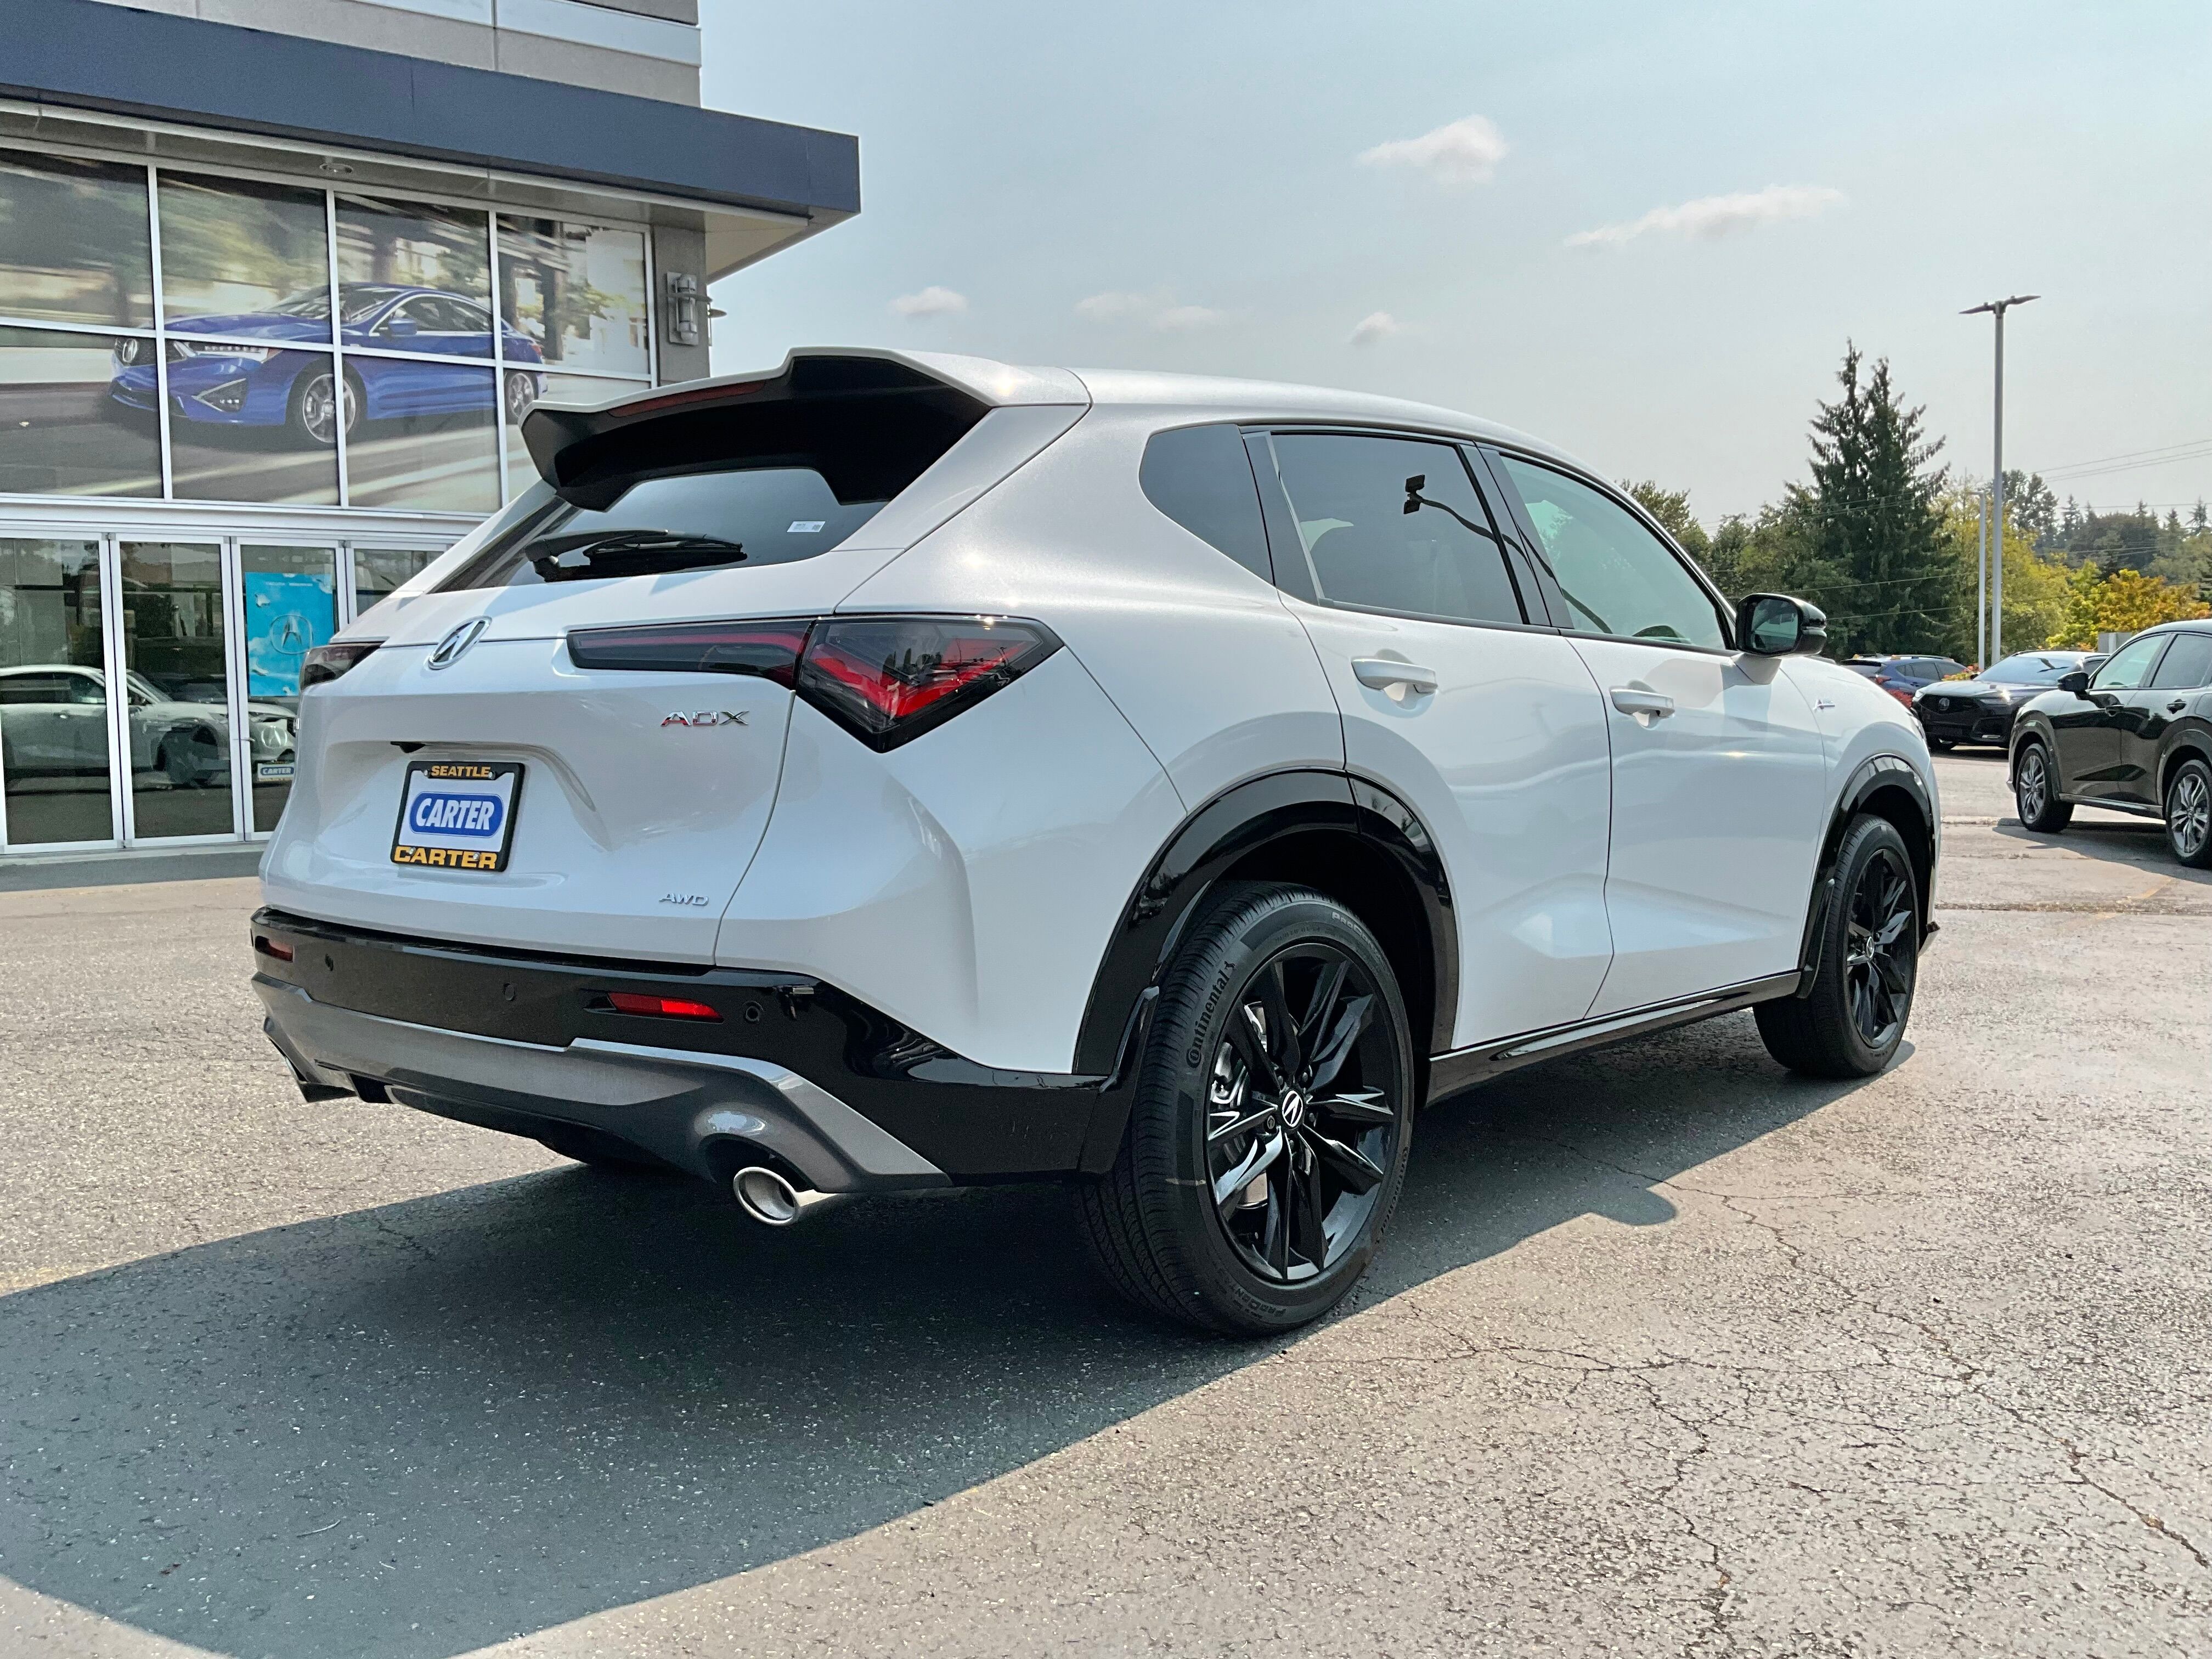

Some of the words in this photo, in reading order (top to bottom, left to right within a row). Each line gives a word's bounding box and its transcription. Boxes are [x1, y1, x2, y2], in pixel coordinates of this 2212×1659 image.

[661, 710, 750, 726] ADX
[431, 765, 490, 778] SEATTLE
[415, 797, 495, 830] CARTER
[393, 845, 498, 870] CARTER
[659, 893, 709, 906] AWD
[1186, 969, 1230, 1068] Continental
